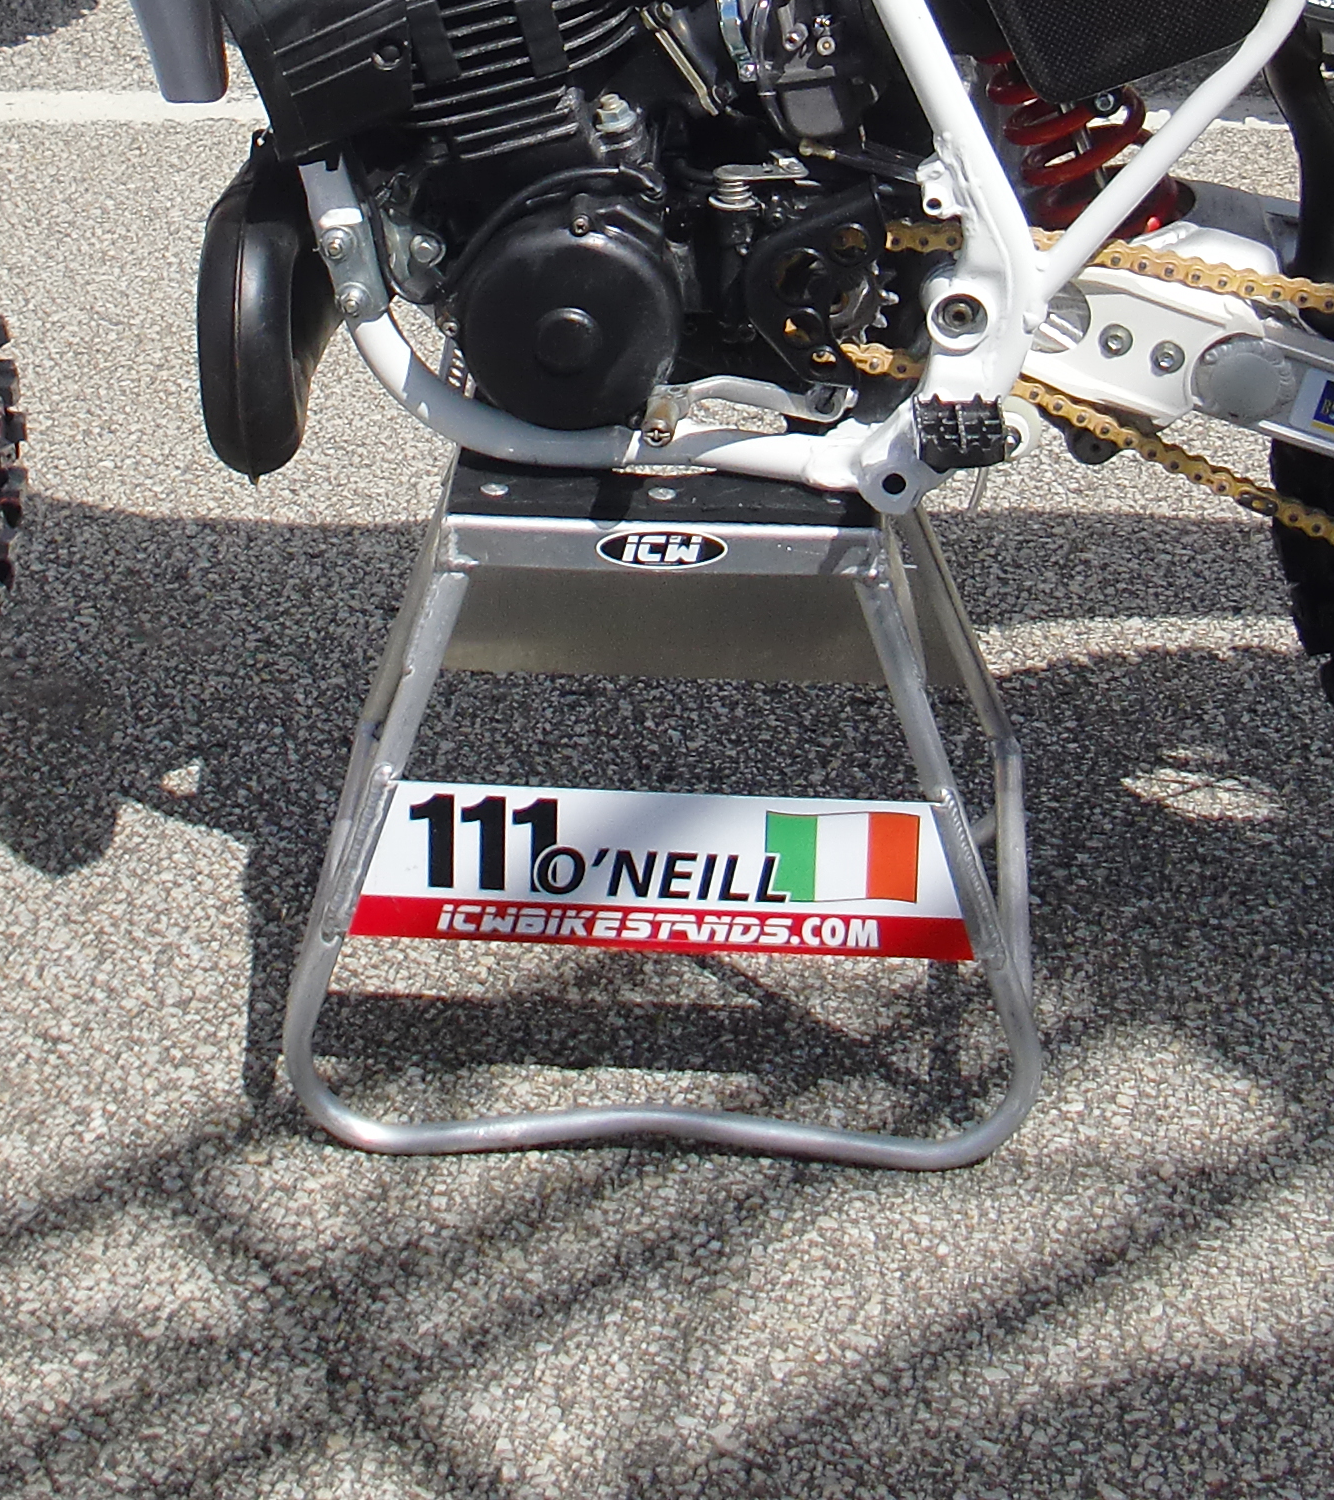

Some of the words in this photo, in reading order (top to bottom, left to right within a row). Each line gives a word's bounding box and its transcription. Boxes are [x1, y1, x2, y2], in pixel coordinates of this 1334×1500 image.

[409, 793, 559, 891] 111
[535, 847, 792, 903] O'NEILL
[437, 903, 880, 949] ICWBIKESTANDS.COM
